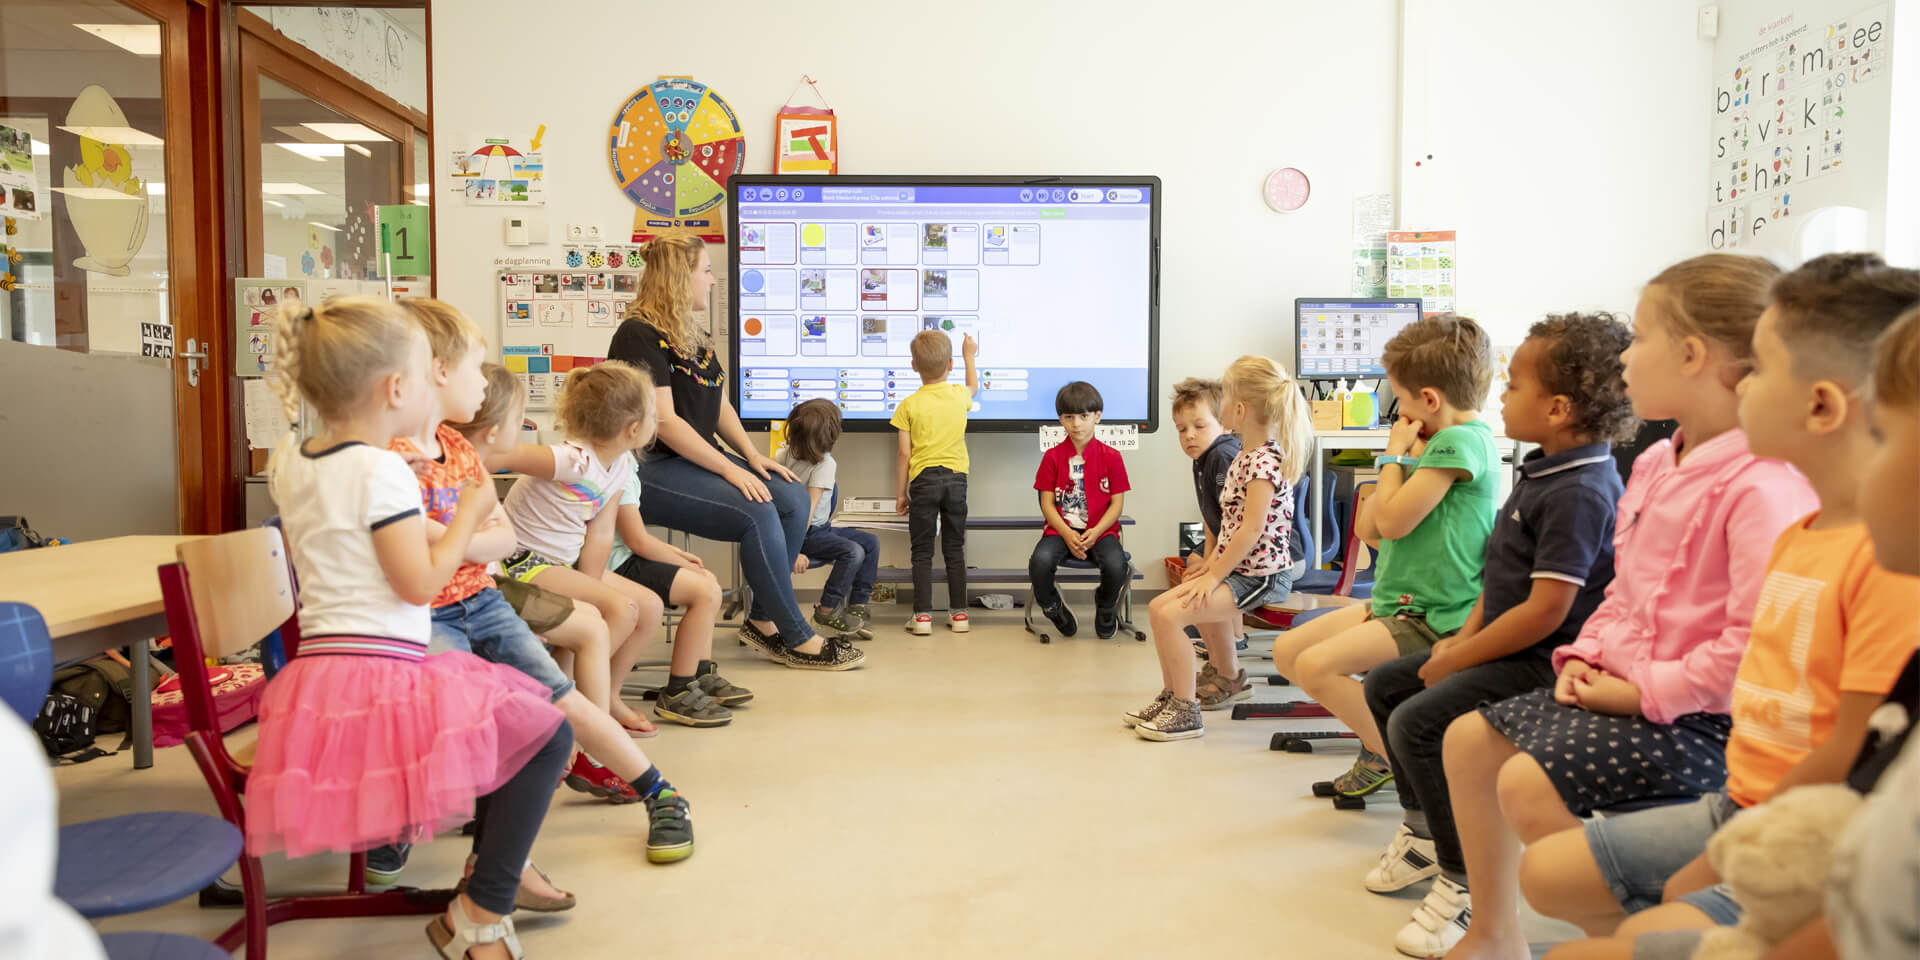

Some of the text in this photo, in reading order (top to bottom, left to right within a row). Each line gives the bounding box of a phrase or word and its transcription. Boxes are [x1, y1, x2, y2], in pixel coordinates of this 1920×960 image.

[1853, 21, 1882, 48] ee
[1802, 48, 1823, 76] m
[1762, 72, 1770, 96] r
[1717, 87, 1730, 114] b
[1804, 97, 1816, 128] k
[1758, 120, 1770, 142] v
[1717, 136, 1725, 158] s
[1806, 145, 1810, 177] i
[1755, 163, 1767, 192] h
[1716, 181, 1723, 203] t
[396, 227, 414, 260] 1
[1711, 219, 1725, 250] d
[494, 256, 551, 267] de dagplanning
